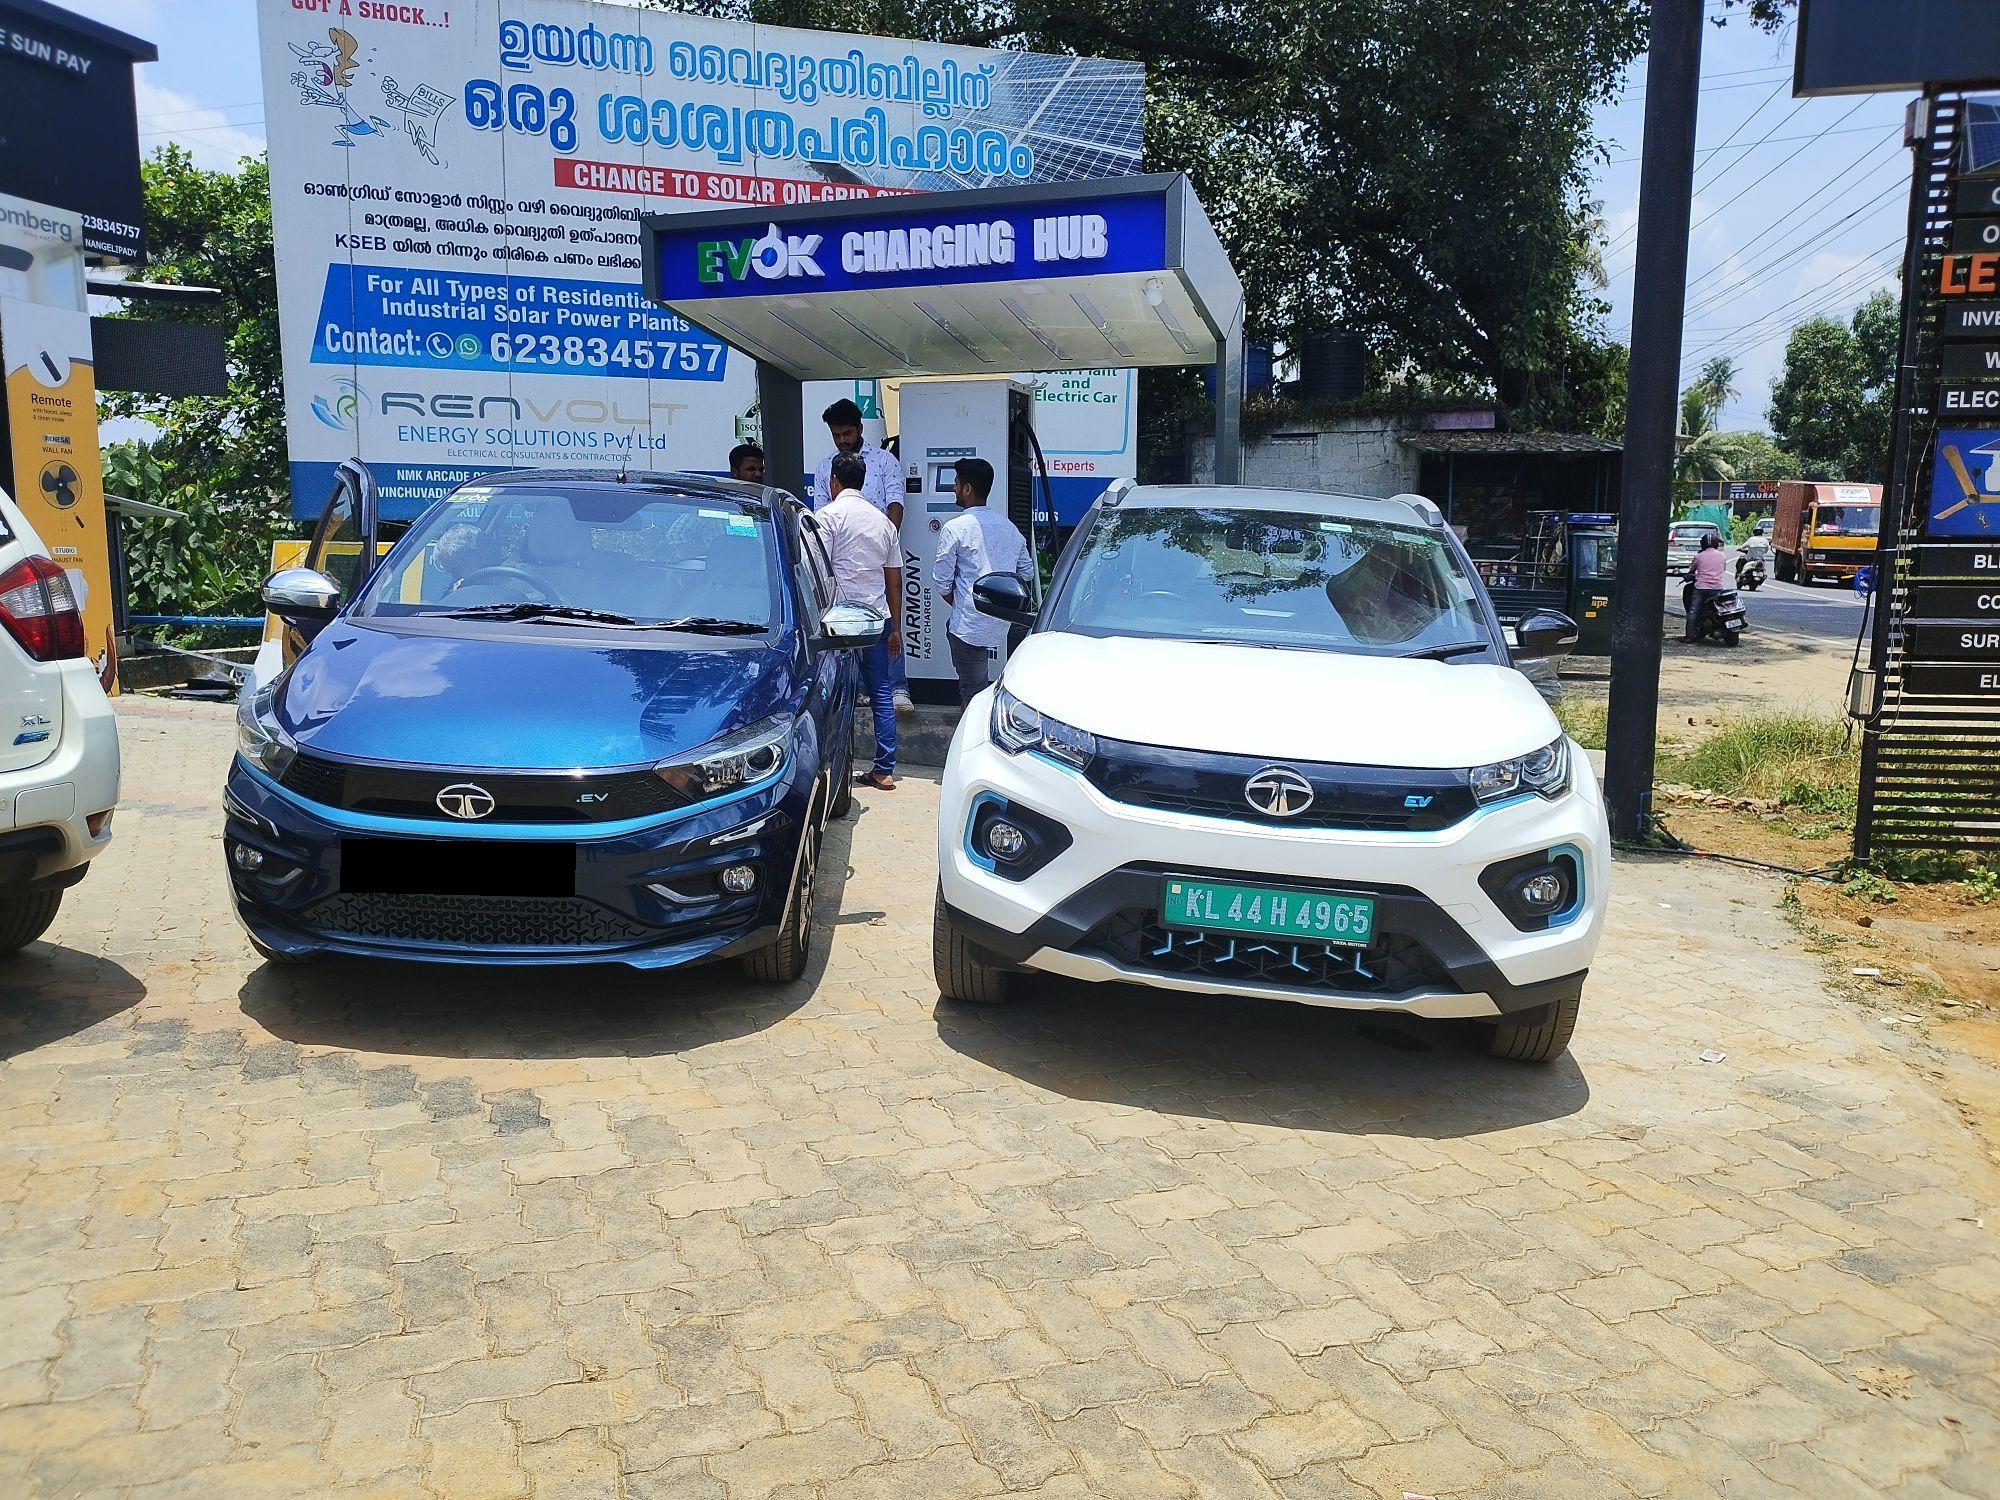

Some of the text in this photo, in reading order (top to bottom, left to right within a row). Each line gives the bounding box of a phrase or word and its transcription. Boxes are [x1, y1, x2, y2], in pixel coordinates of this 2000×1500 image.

[339, 0, 352, 15] A
[358, 1, 449, 28] SHOCK...!
[10, 33, 51, 60] SUN
[56, 49, 91, 74] PAY
[500, 20, 996, 119] ഉയർന്ന വൈദ്യുതിബില്ലിന്
[417, 87, 446, 107] BILLS
[464, 79, 1034, 178] ഒരു ശാശ്വതപരിഹാരം
[574, 164, 665, 194] CHANGE
[672, 173, 700, 197] TO
[707, 173, 776, 203] SOLAR
[303, 183, 392, 201] ഓൺഗ്രിഡ്
[394, 190, 462, 208] സോളാർ
[518, 199, 546, 214] വഴി
[365, 213, 641, 245] മാത്രമല്ല, അധിക വൈദ്യുതി ഉത്പാദന
[841, 220, 1015, 273] CHARGING
[1033, 214, 1108, 262] HUB
[85, 239, 137, 258] NANGELIPADY
[335, 234, 386, 251] KSEB
[393, 238, 431, 254] യിൽ
[436, 241, 488, 261] നിന്നും
[493, 246, 549, 262] തിരികെ
[554, 252, 593, 266] പണം
[367, 275, 403, 294] For
[411, 277, 439, 296] All
[446, 280, 508, 302] Types
[516, 286, 535, 302] of
[382, 298, 690, 332] Industrial Solar Power Plants
[325, 323, 722, 372] Contact: 6238345757
[1034, 389, 1118, 403] Electric Car
[1062, 377, 1091, 389] and
[31, 393, 72, 408] Remote
[381, 392, 689, 426] RENVOLT
[42, 446, 59, 454] WALL
[398, 425, 666, 450] ENERGY SOLUTIONS Pvt Ltd
[448, 449, 632, 462] ELECTRICAL CONSULTANTS & CONTRACTORS
[1053, 460, 1095, 473] Experts
[397, 469, 423, 481] NMK
[426, 470, 470, 482] ARCADE
[1974, 554, 2000, 569] BL
[905, 549, 921, 659] HARMONY
[923, 587, 932, 659] FAST CHARGER
[1404, 795, 1433, 807] EV
[1186, 888, 1219, 919] KL
[1228, 893, 1261, 924] 44
[1270, 896, 1286, 926] H
[1296, 899, 1368, 934] 4965
